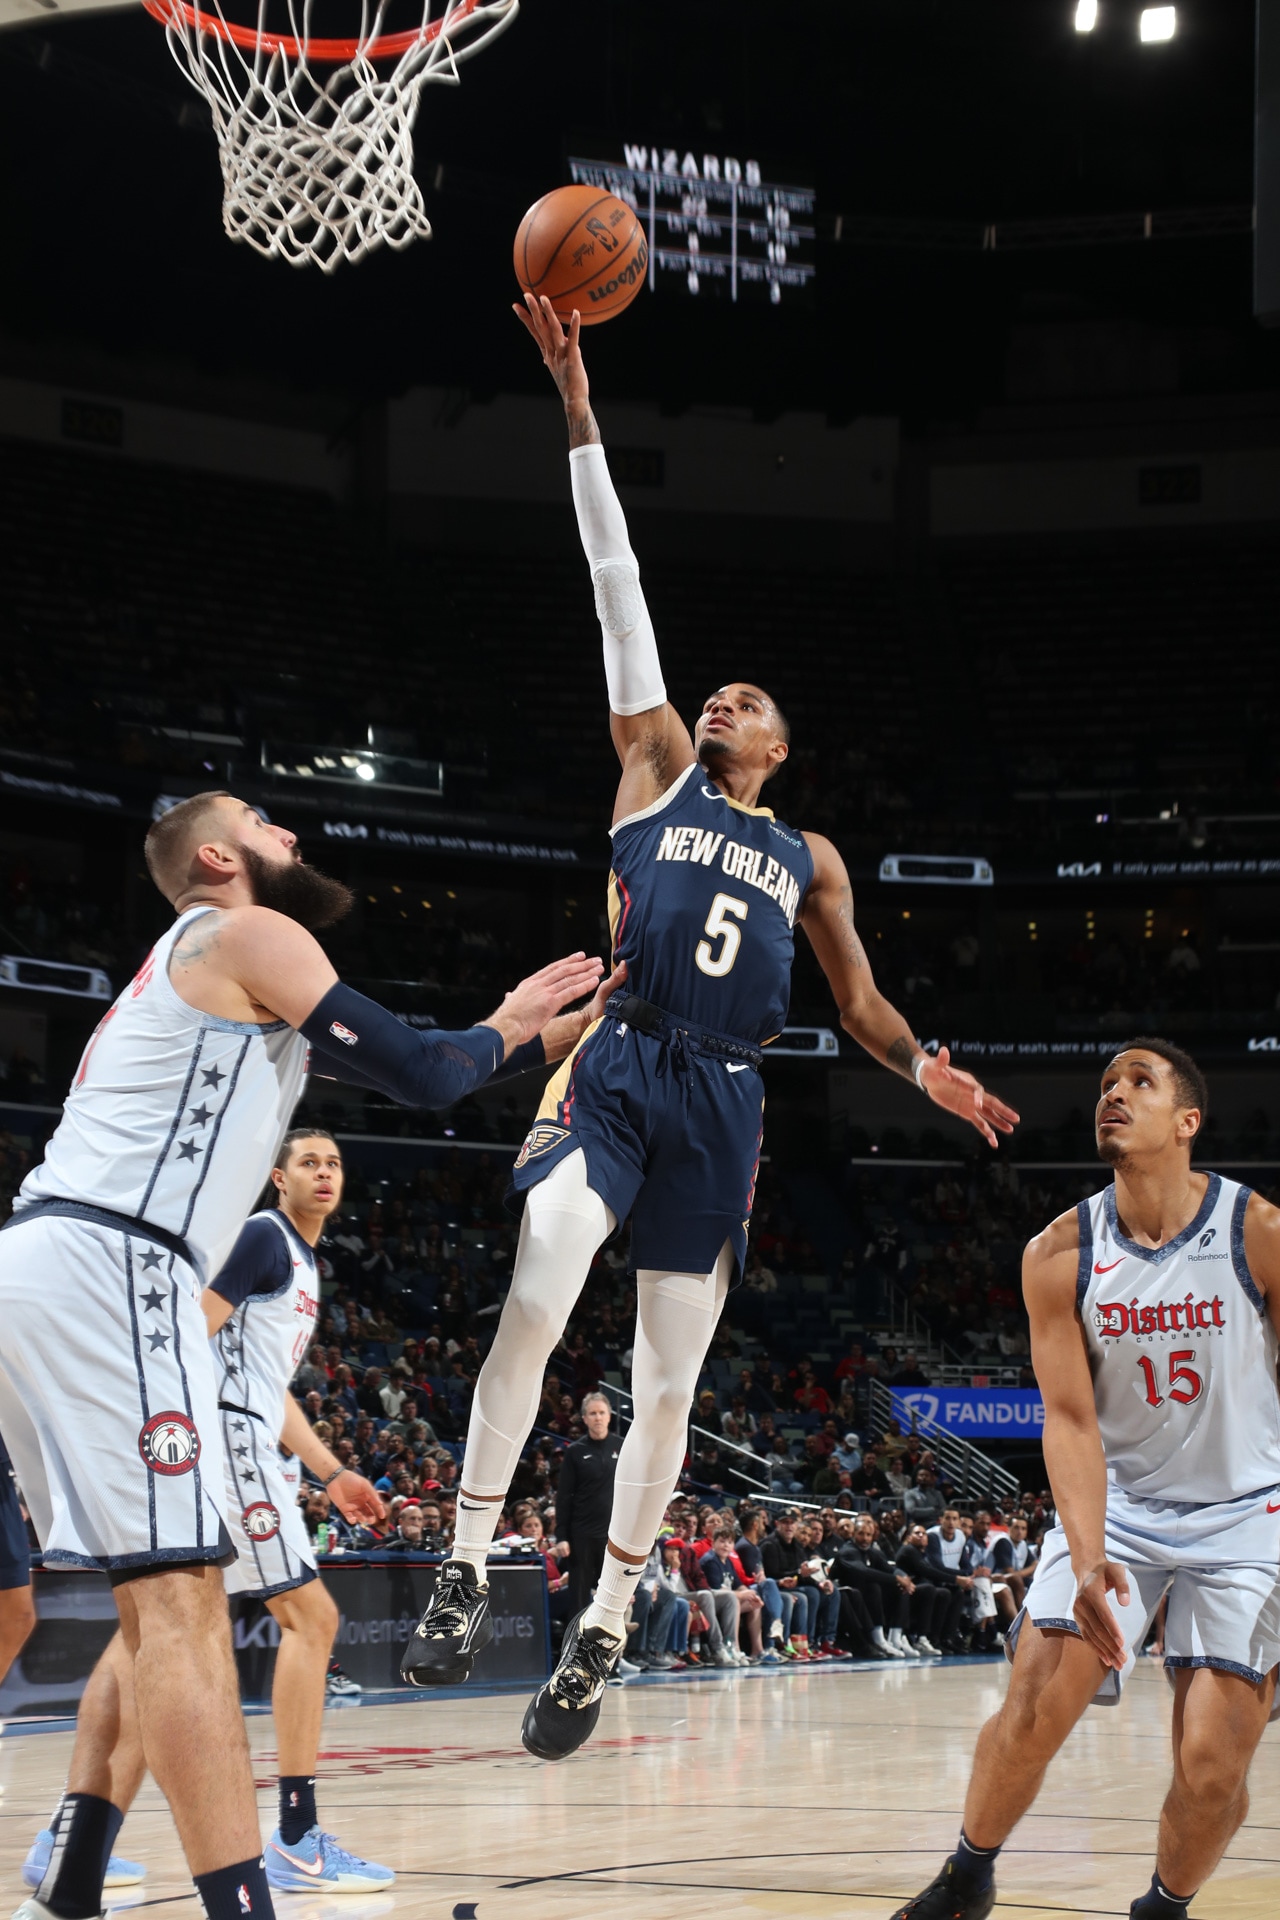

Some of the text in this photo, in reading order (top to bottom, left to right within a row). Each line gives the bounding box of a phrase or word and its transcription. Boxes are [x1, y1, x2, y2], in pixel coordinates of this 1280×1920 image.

[623, 143, 761, 188] WIZARDS
[656, 826, 801, 930] NEW ORLEANS
[1056, 860, 1102, 878] KIA
[1123, 860, 1150, 877] only
[1151, 861, 1178, 877] your
[1179, 859, 1211, 874] seats
[1212, 859, 1241, 873] were
[694, 892, 749, 978] 5
[961, 1041, 987, 1056] only
[988, 1042, 1016, 1056] your
[1017, 1041, 1049, 1054] seats
[1050, 1042, 1080, 1054] were
[1082, 1042, 1096, 1054] as
[1187, 1252, 1229, 1262] Robinhood
[1093, 1312, 1118, 1327] the
[1095, 1292, 1227, 1338] District
[1136, 1329, 1224, 1344] COLUMBIA
[1136, 1349, 1204, 1409] 15
